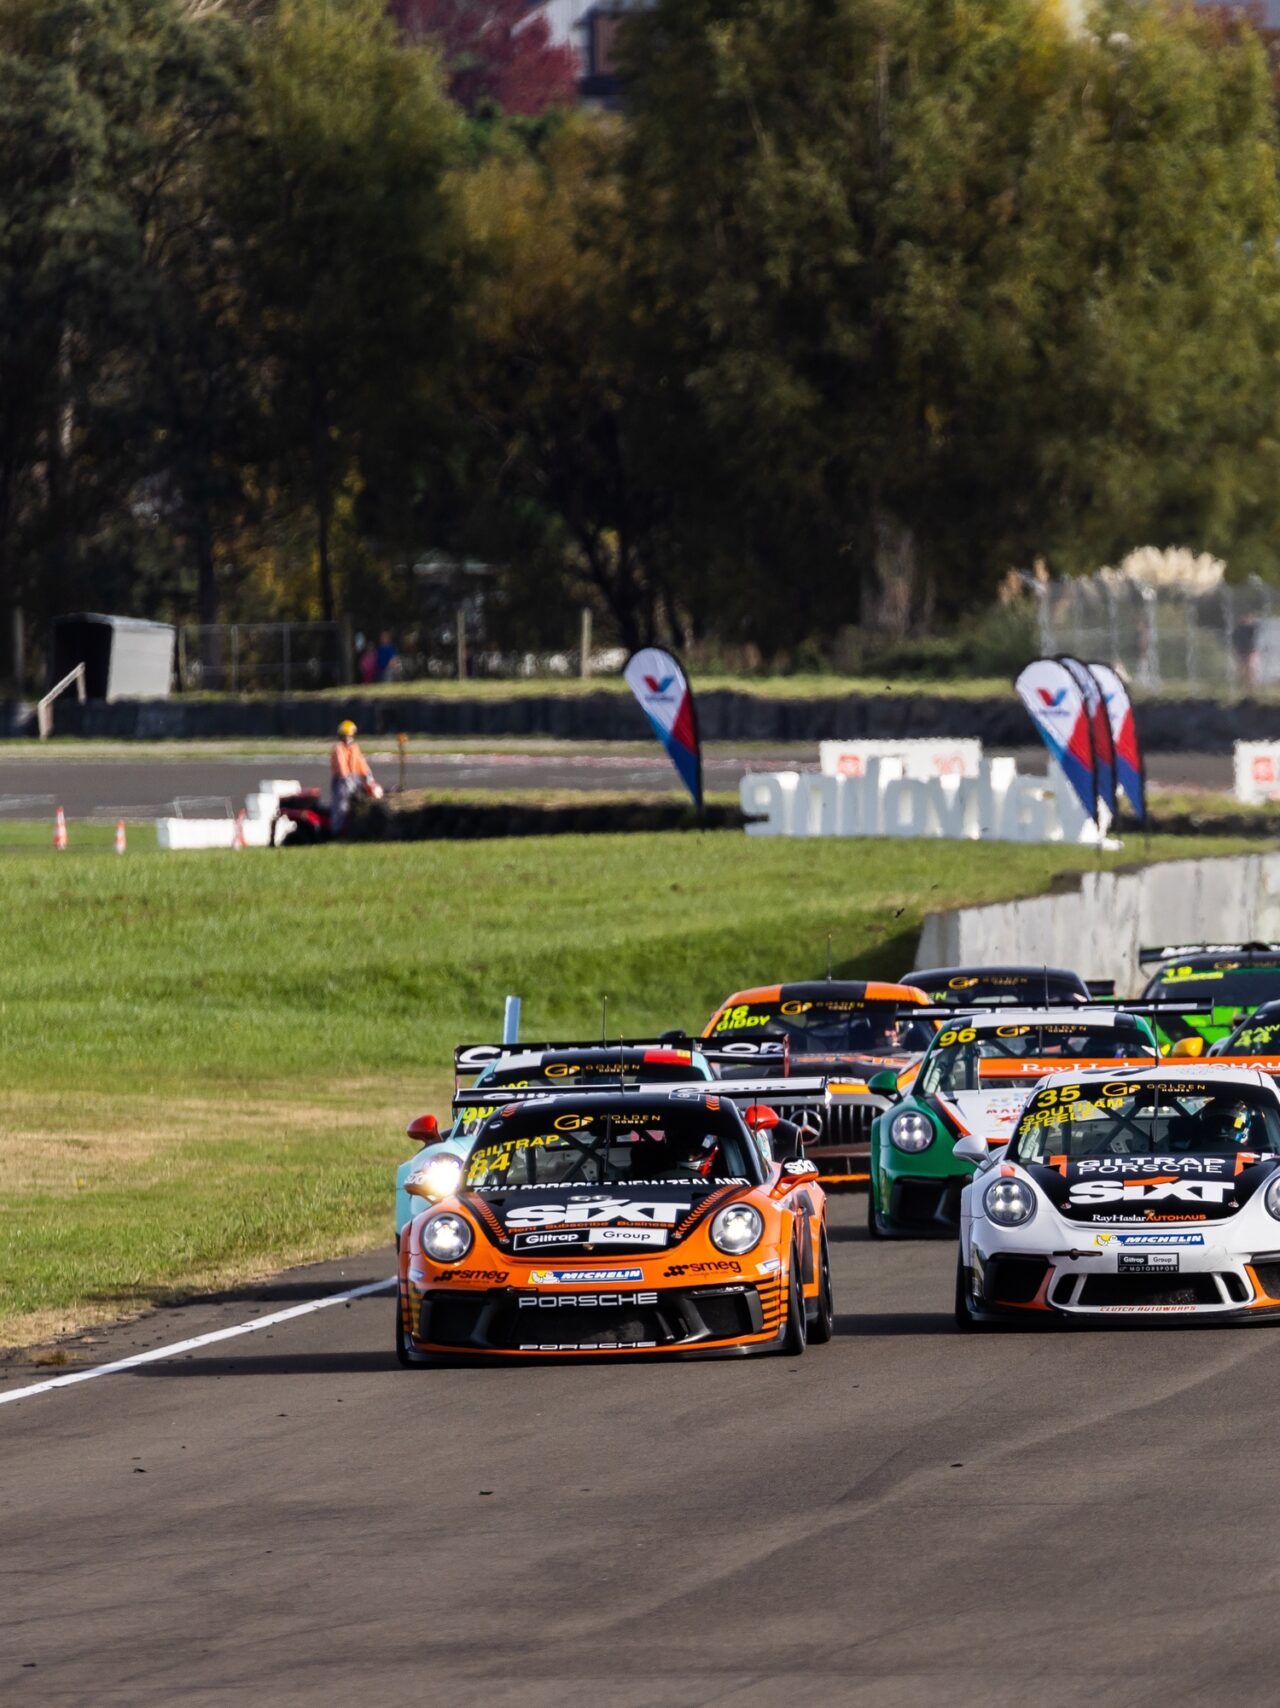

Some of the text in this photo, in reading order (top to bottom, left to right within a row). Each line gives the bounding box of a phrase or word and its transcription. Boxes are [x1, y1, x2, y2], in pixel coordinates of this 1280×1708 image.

[939, 1028, 977, 1046] 96
[1037, 1084, 1081, 1108] 35
[1023, 1098, 1124, 1124] SOUTHAM
[1018, 1110, 1094, 1135] STEELE
[471, 1134, 559, 1161] GILTRAP
[467, 1152, 511, 1179] 84
[1077, 1157, 1226, 1167] GILTRAP
[1079, 1165, 1223, 1175] PORSCHE
[1069, 1176, 1235, 1204] SIXT
[505, 1199, 691, 1228] SIXT
[525, 1231, 651, 1244] Giltrap Group
[1125, 1235, 1201, 1243] MICHELIN
[690, 1260, 742, 1273] smeg
[460, 1269, 510, 1283] smeg
[560, 1270, 641, 1280] MICHELIN
[518, 1292, 659, 1308] PORSCHE
[519, 1341, 657, 1350] PORSCHE
